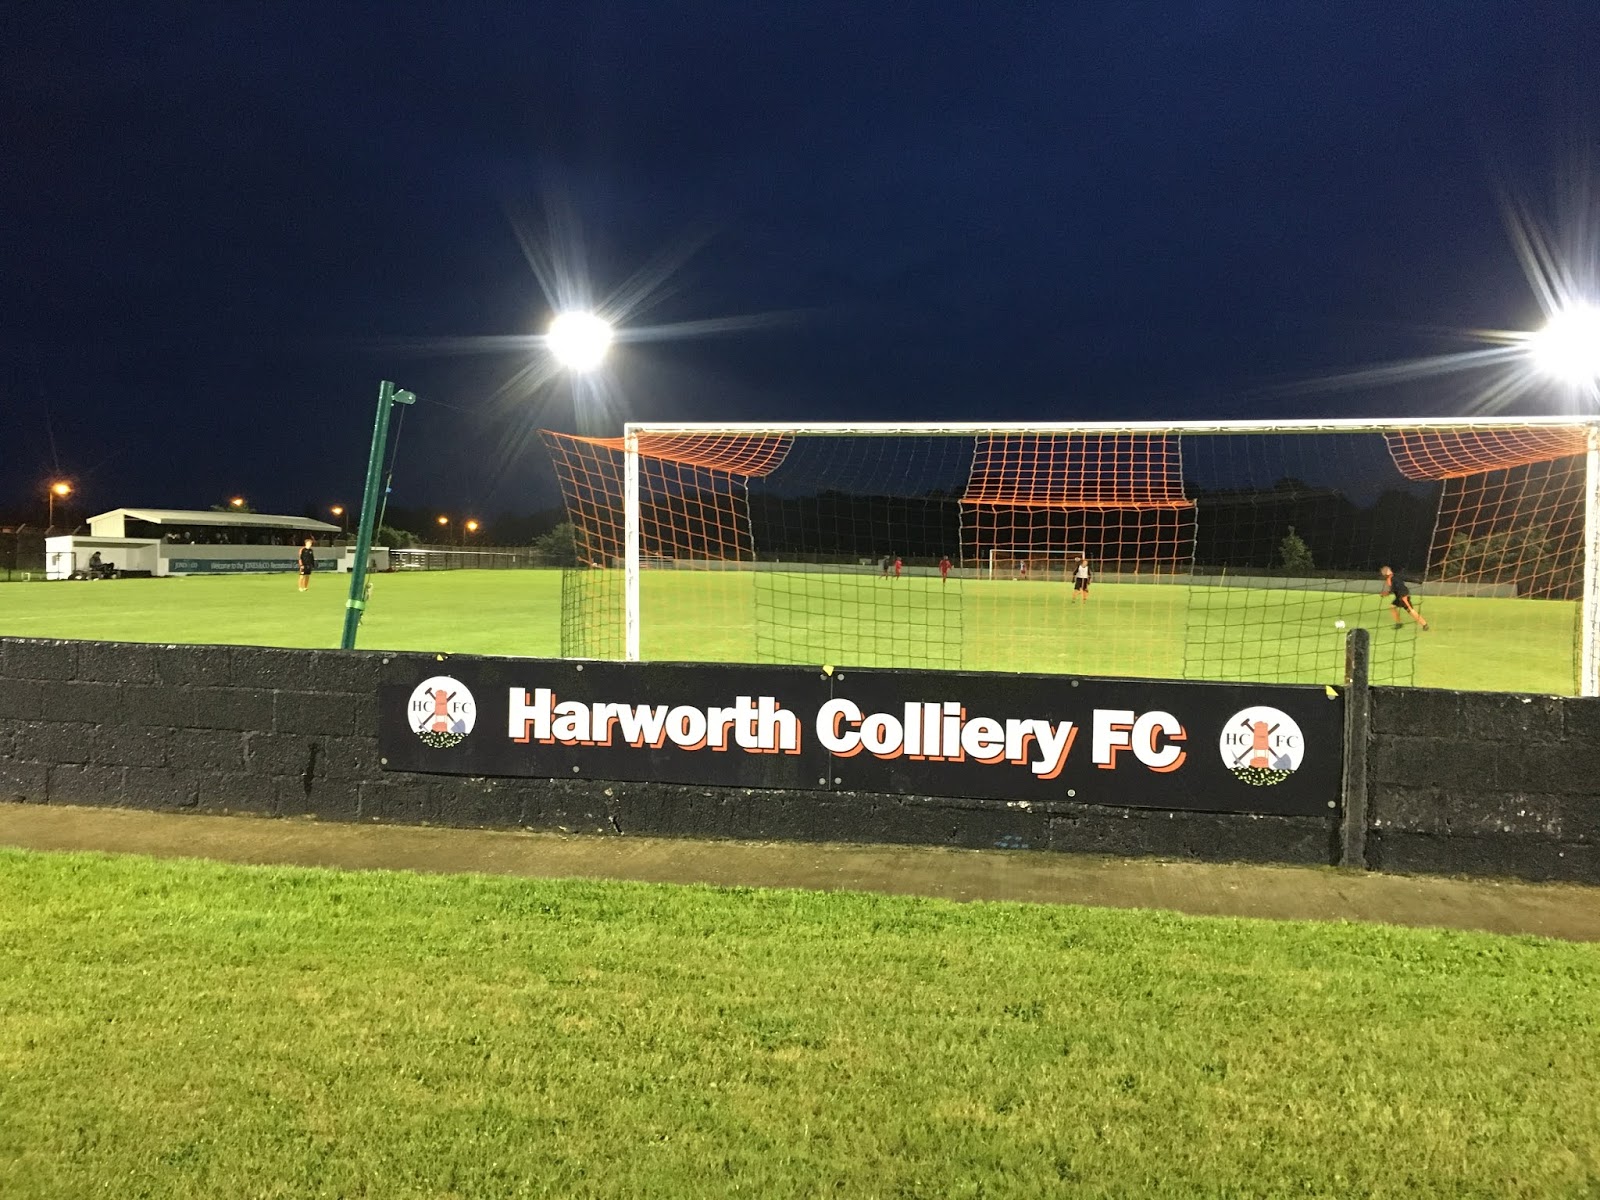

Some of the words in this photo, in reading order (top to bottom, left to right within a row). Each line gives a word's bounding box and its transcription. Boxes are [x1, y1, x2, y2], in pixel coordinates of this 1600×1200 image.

[412, 700, 433, 713] HC
[452, 701, 472, 714] FC
[508, 686, 801, 755] Harworth
[815, 698, 1078, 780] Colliery
[1092, 708, 1187, 773] FC
[1226, 732, 1251, 746] HC
[1275, 734, 1299, 748] FC
